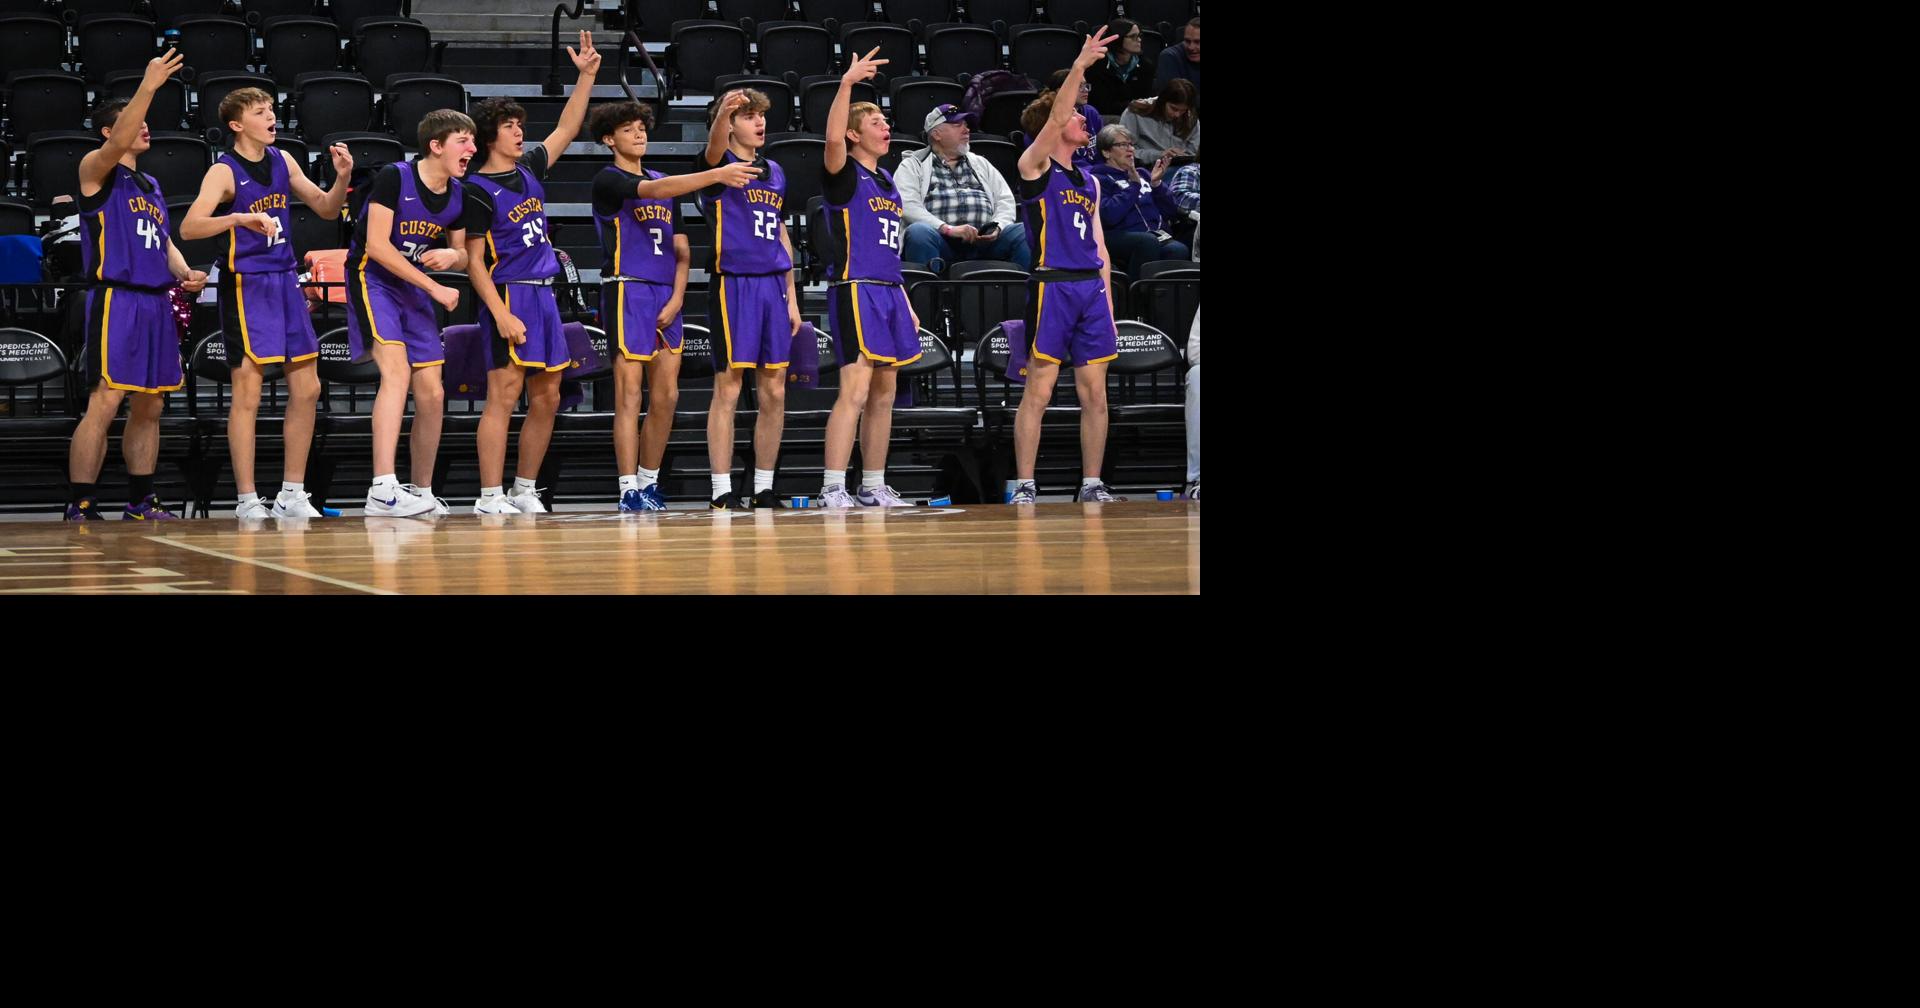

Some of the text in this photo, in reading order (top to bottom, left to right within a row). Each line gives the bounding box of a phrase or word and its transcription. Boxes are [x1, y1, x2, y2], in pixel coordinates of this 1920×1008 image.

[744, 189, 783, 211] USTER
[400, 220, 442, 239] CUSTE
[752, 210, 777, 241] 22
[878, 216, 900, 249] 32
[1073, 211, 1087, 241] 4
[649, 228, 664, 256] 2
[8, 348, 50, 356] MEDICINE
